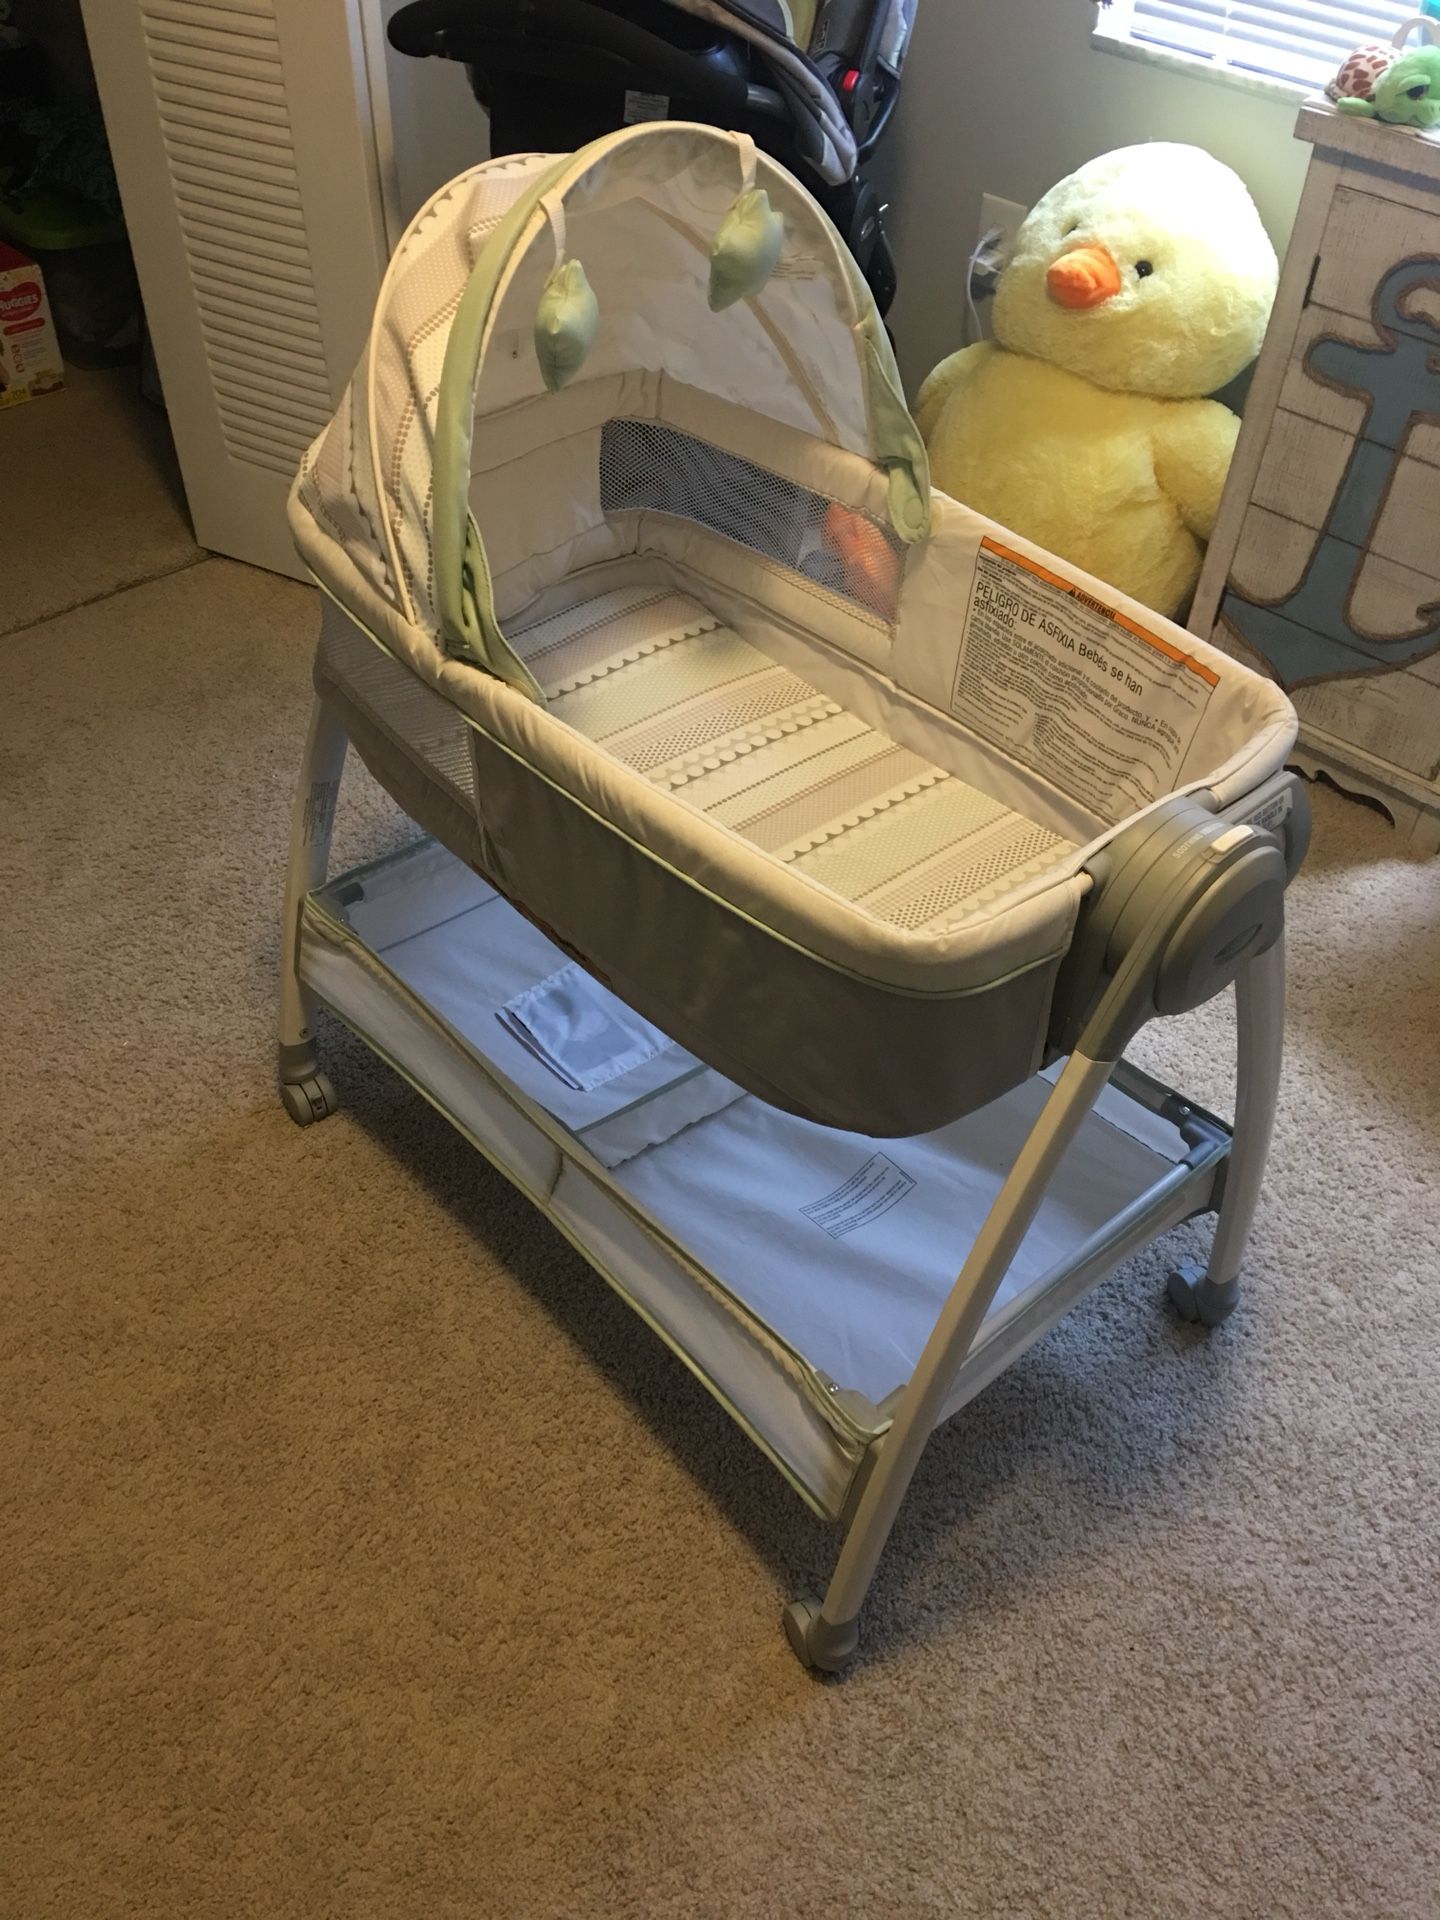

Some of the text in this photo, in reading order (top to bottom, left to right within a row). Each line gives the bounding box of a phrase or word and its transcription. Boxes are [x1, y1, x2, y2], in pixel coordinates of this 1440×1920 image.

[973, 596, 1017, 630] asfixiado:
[976, 582, 1020, 617] PELIGRO
[1020, 608, 1037, 627] DE
[1038, 618, 1075, 652] ASFIXIA
[1078, 642, 1109, 672] Bebés
[1110, 666, 1124, 681] se
[1124, 673, 1143, 697] han
